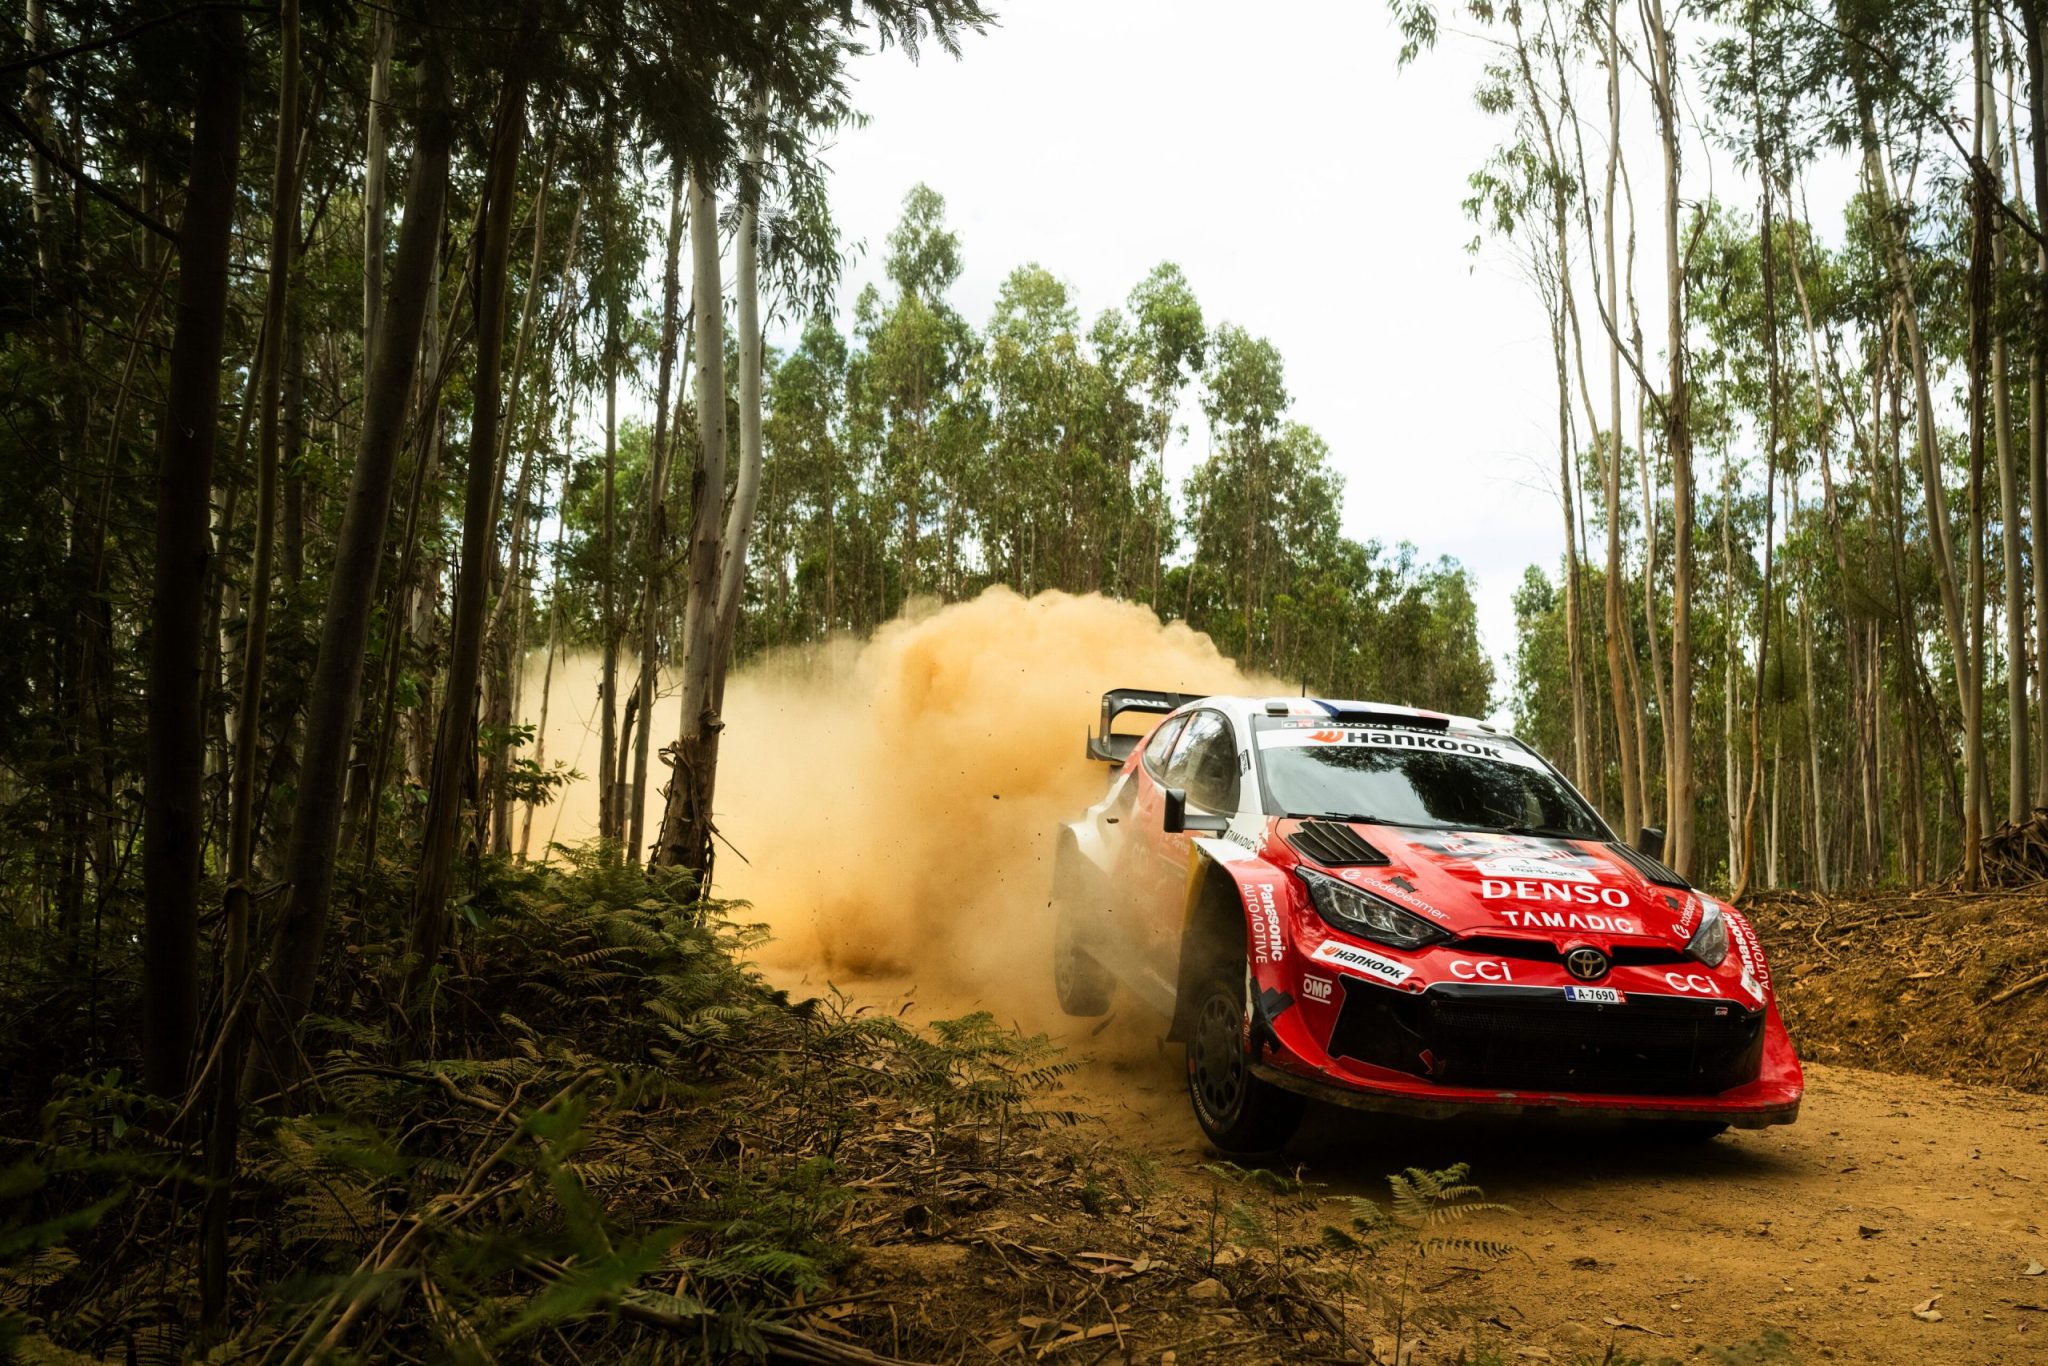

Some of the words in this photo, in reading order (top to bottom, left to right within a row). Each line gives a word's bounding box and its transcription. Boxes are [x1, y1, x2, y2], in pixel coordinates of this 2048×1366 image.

[1320, 721, 1388, 729] TOYOTA
[1347, 732, 1504, 759] Hankook
[1364, 877, 1447, 920] codebeamer
[1480, 880, 1630, 908] DENSO
[1500, 911, 1634, 934] TAMADIC
[1723, 912, 1755, 975] anasonic
[1334, 950, 1405, 979] Hankook
[1303, 978, 1332, 998] OMP
[1578, 988, 1615, 1001] A-7690
